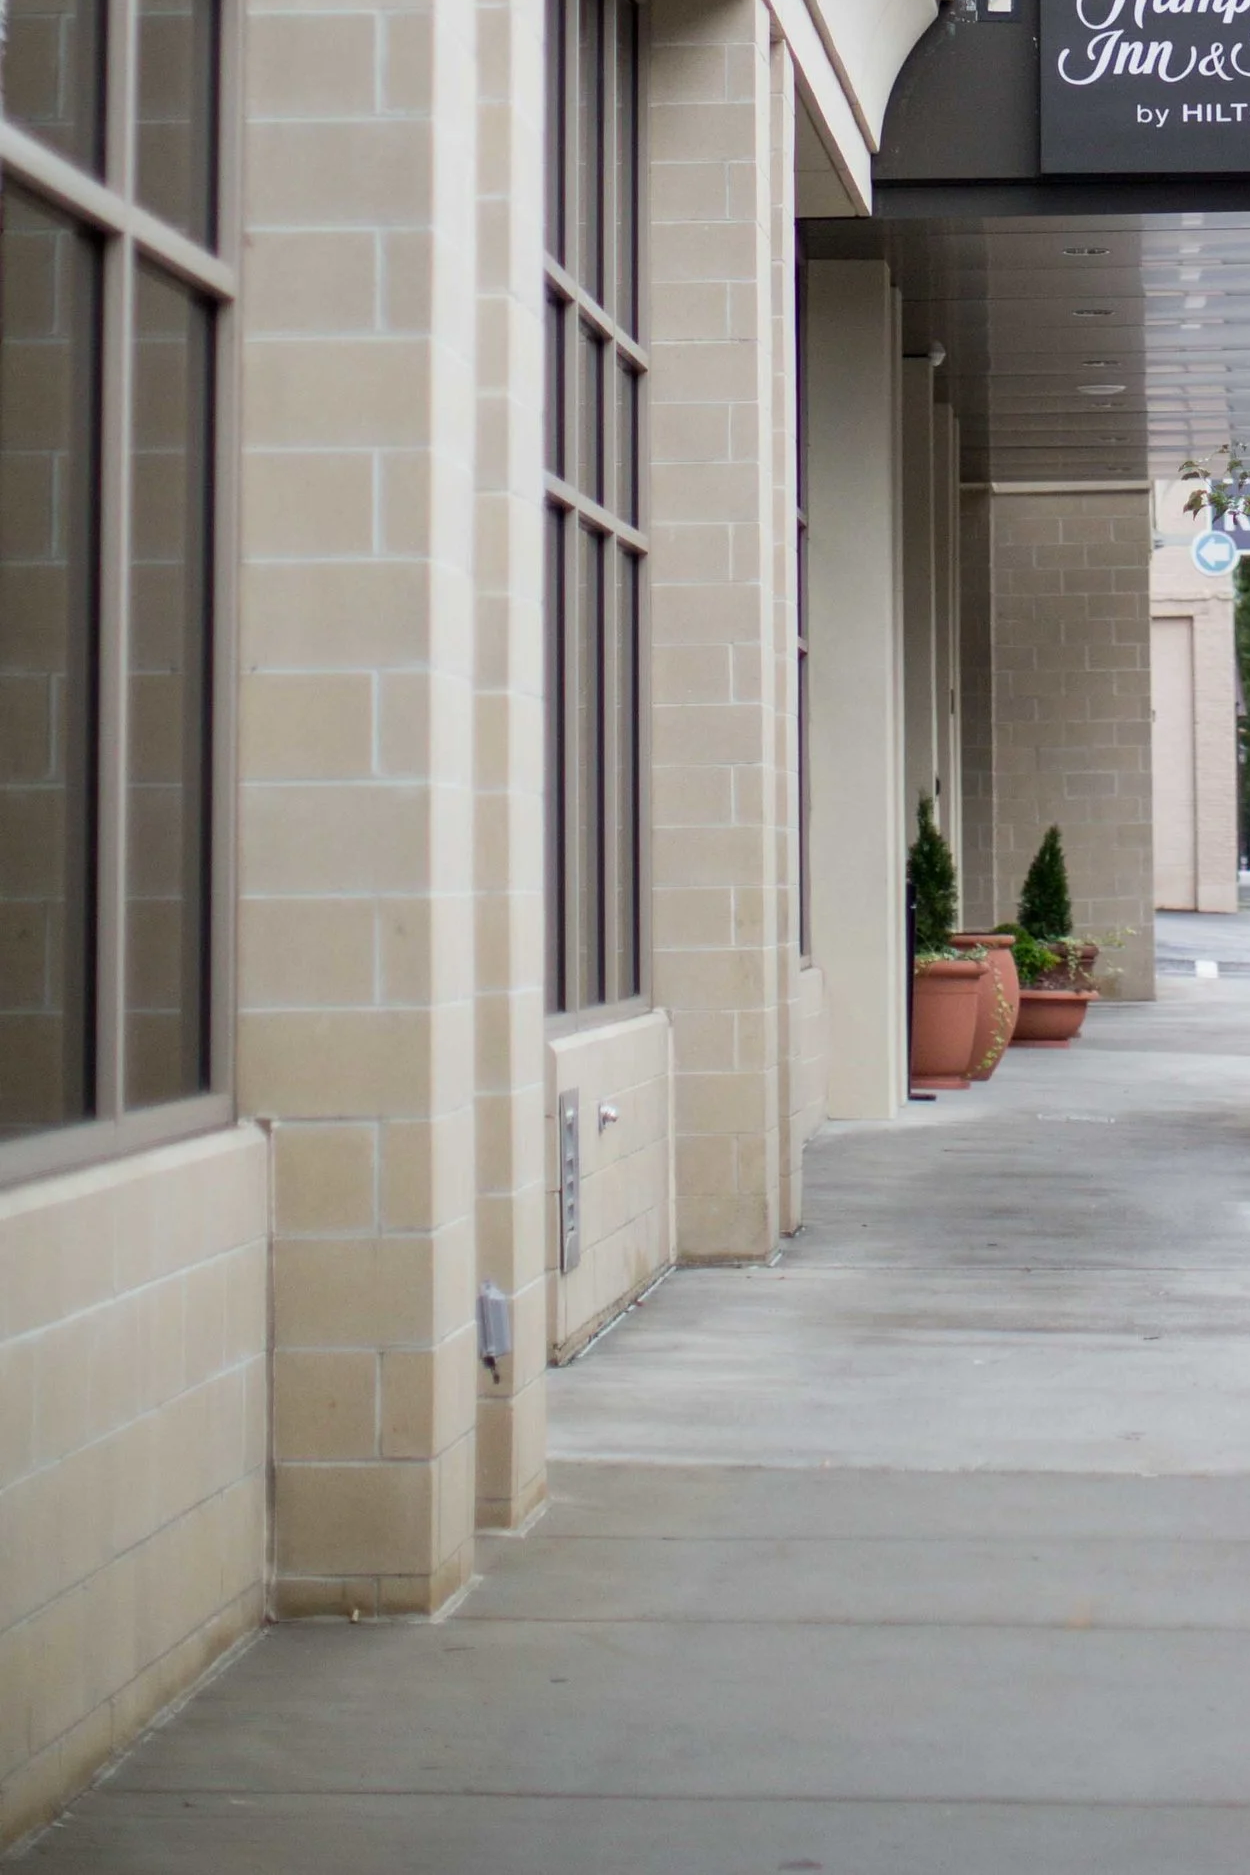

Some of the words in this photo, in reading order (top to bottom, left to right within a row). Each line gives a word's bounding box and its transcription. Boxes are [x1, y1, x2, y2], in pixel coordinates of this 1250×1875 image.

[1058, 30, 1197, 86] Inn
[1200, 42, 1233, 82] &
[1136, 104, 1169, 128] by
